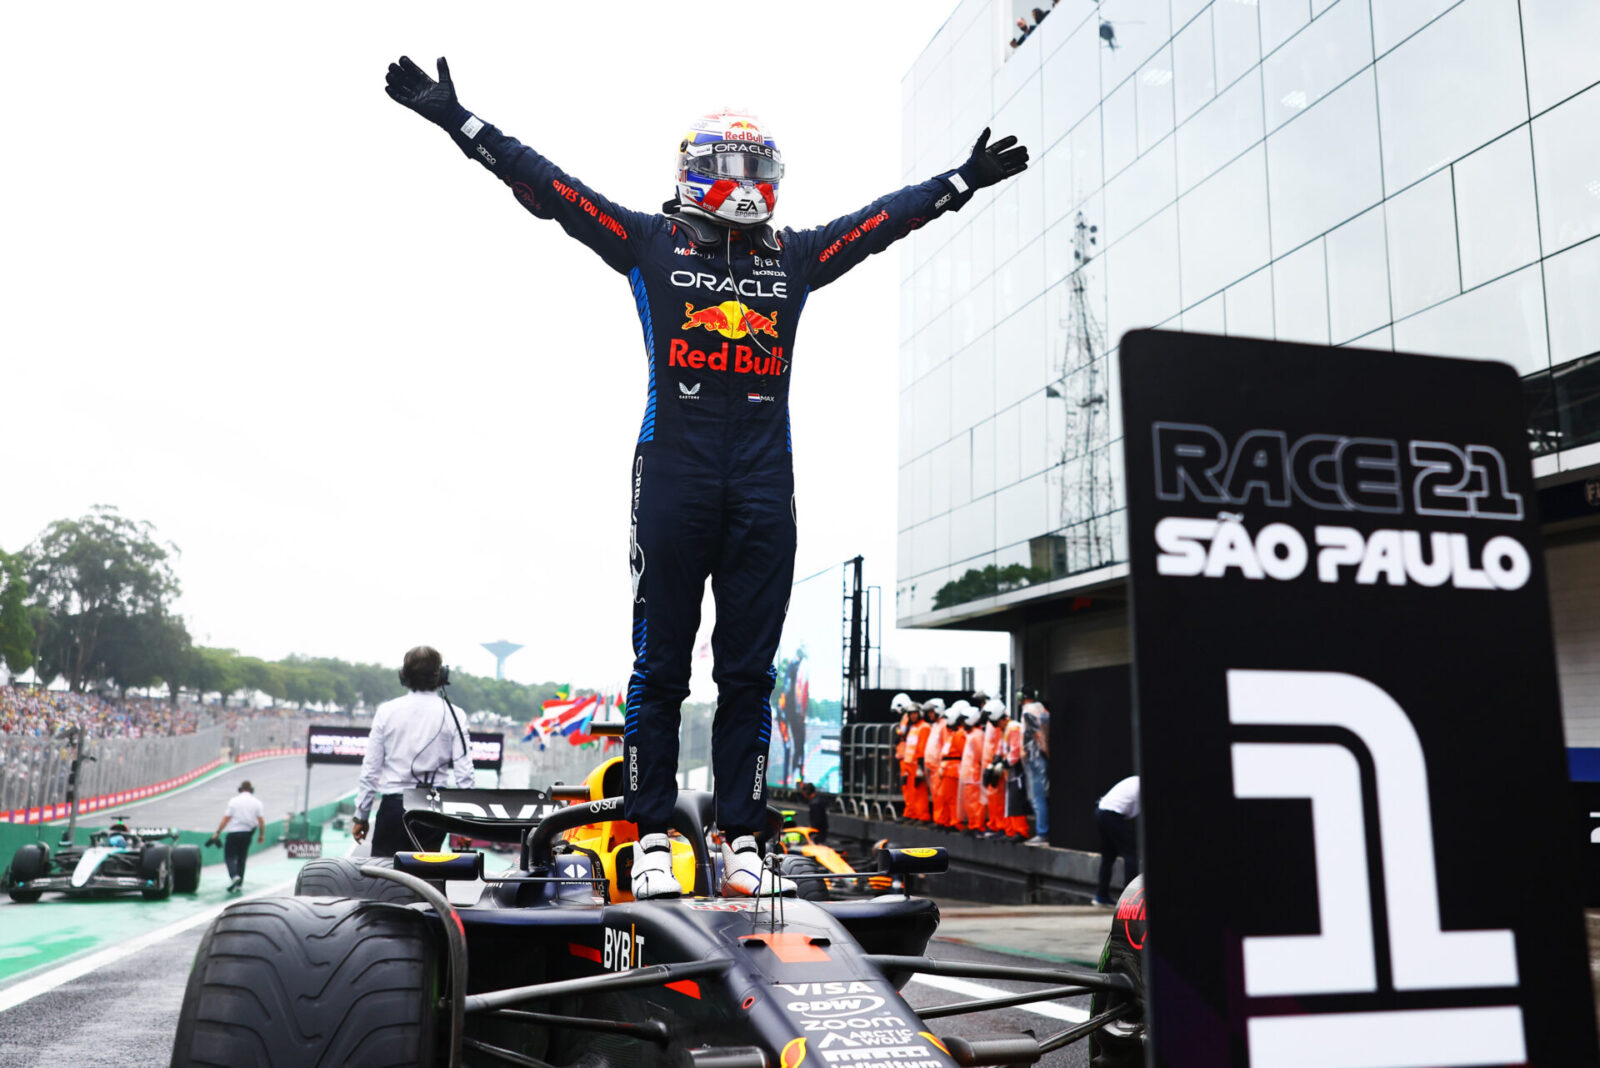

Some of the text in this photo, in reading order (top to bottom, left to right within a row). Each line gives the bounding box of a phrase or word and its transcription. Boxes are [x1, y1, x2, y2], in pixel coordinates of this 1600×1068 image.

[714, 143, 772, 157] ORACLE
[725, 131, 763, 143] Red Bull
[552, 179, 579, 202] GIVES
[579, 196, 599, 217] YOU
[598, 211, 627, 240] WINGS
[736, 199, 758, 211] EA
[819, 239, 843, 262] GIVES
[842, 227, 861, 245] YOU
[860, 209, 889, 232] WINGS
[670, 270, 788, 299] ORACLE
[668, 338, 783, 376] Red Bull
[1151, 421, 1525, 521] RACE 21
[1155, 511, 1531, 591] SÃO PAULO
[629, 745, 638, 791] sparco
[752, 755, 765, 800] sparco
[1226, 668, 1527, 1068] 1
[603, 923, 645, 972] BYBIT
[773, 981, 875, 996] VISA
[786, 999, 861, 1012] CDW
[850, 1028, 914, 1039] ARCTIC
[860, 1036, 914, 1046] WOLF
